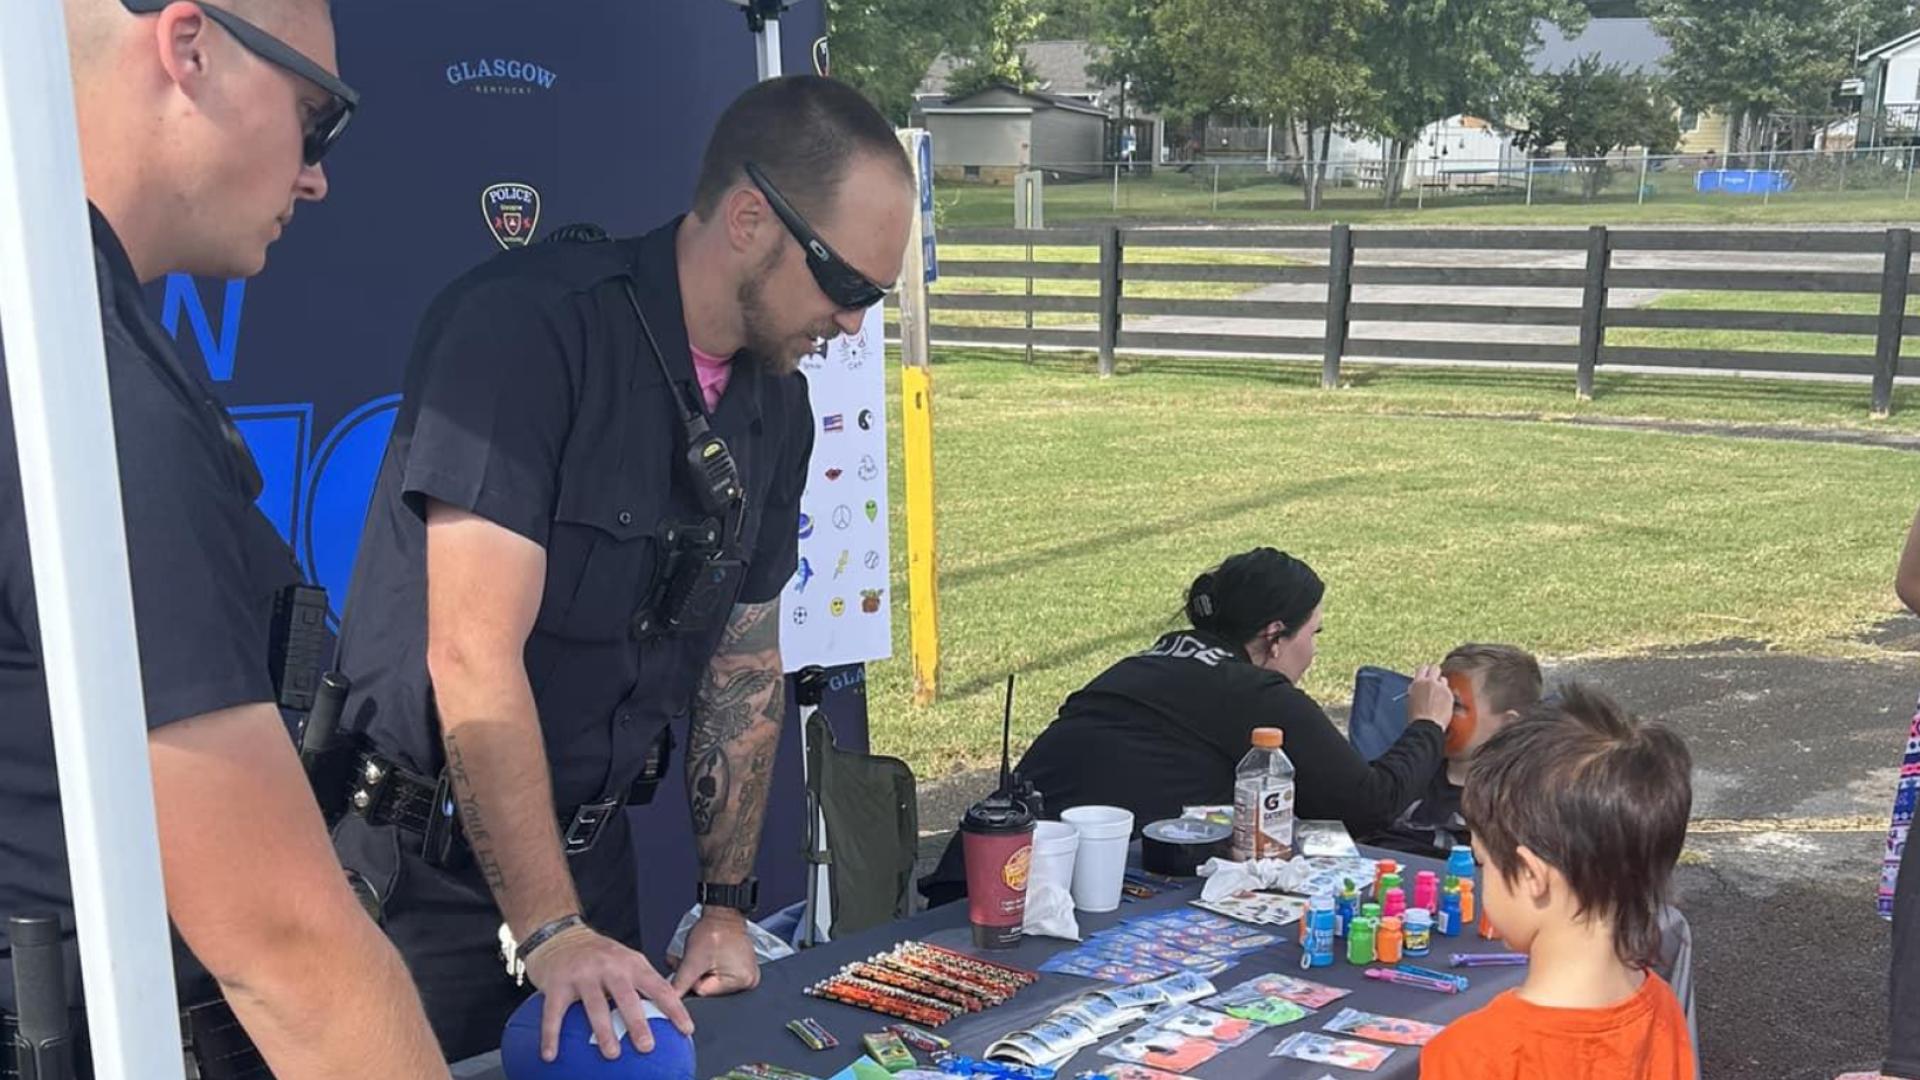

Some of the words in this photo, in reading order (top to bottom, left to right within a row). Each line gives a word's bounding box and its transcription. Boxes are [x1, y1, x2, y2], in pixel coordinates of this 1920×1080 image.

[446, 58, 557, 89] GLASGOW
[489, 187, 532, 203] POLICE
[1264, 792, 1280, 811] G
